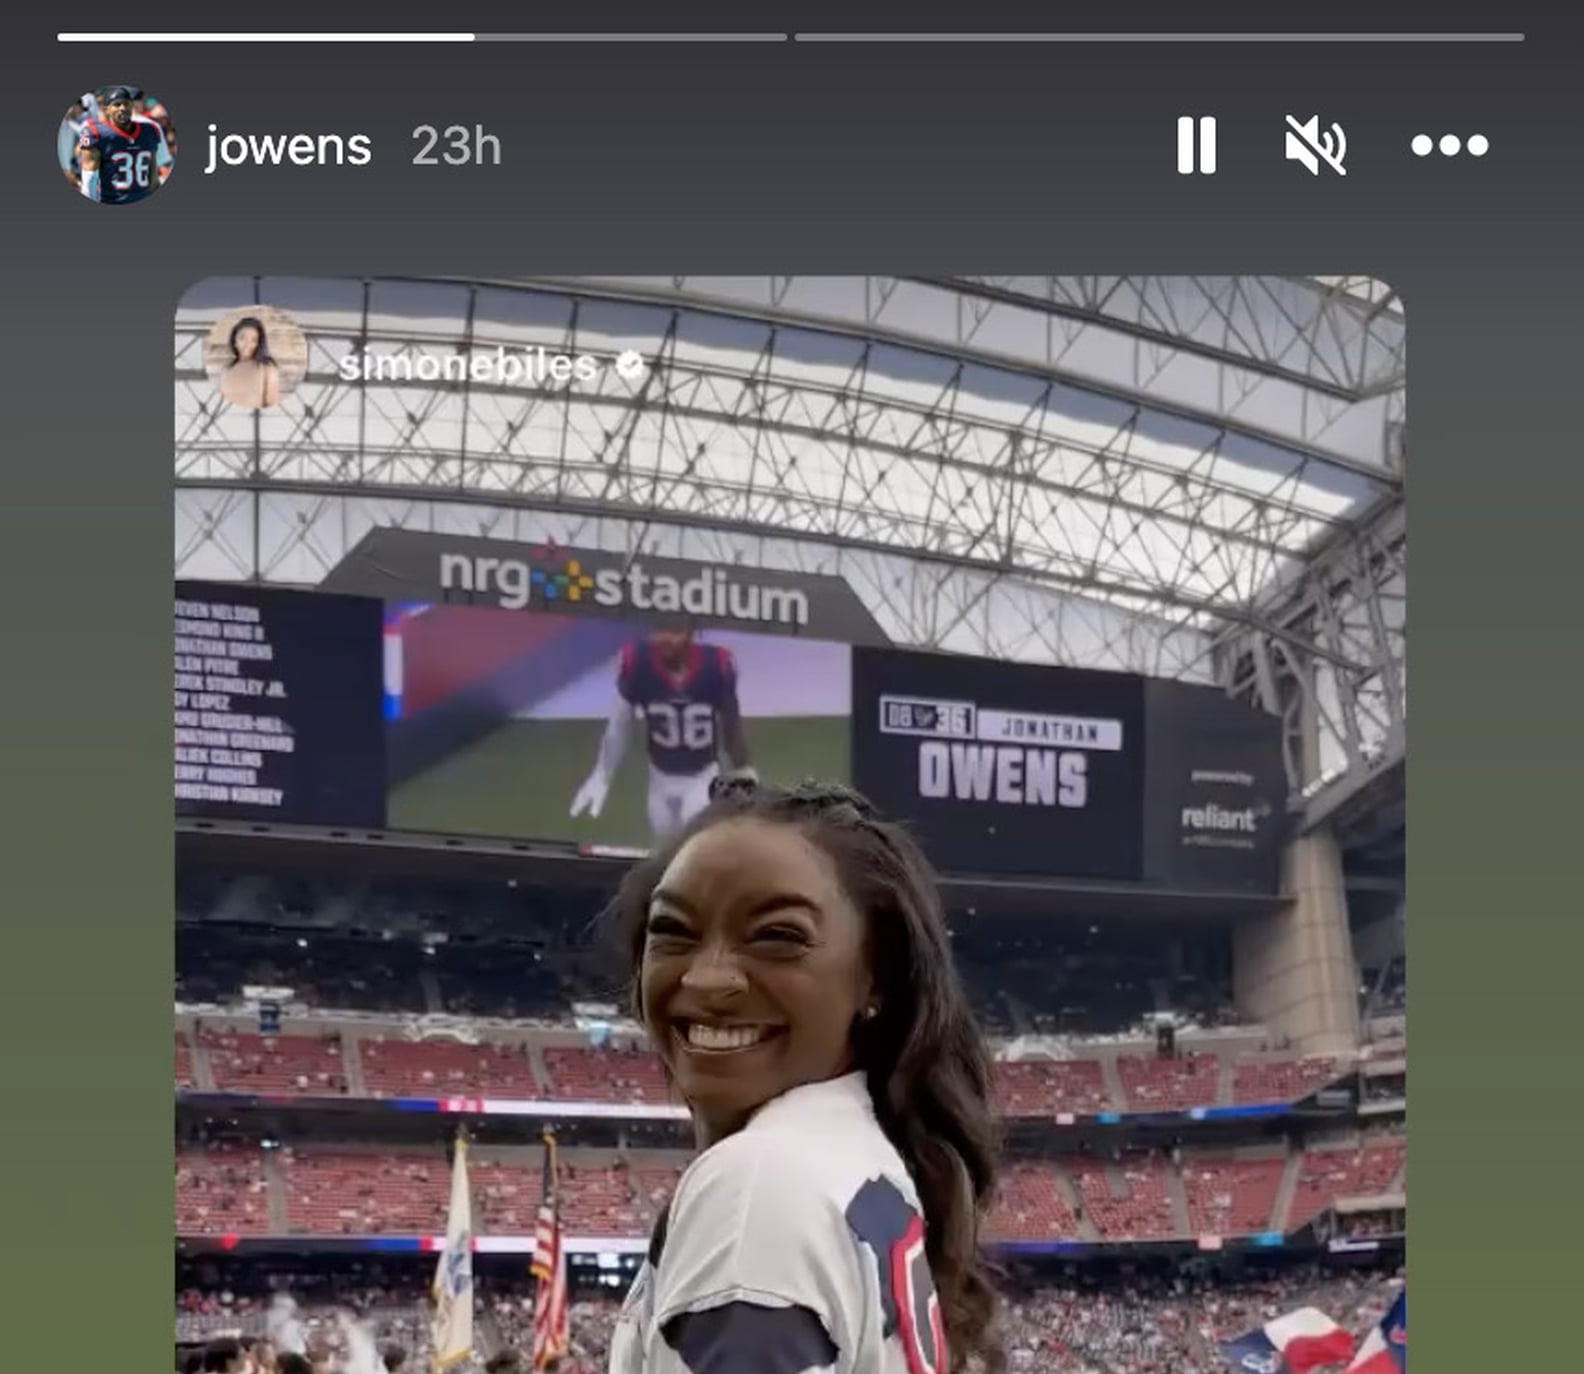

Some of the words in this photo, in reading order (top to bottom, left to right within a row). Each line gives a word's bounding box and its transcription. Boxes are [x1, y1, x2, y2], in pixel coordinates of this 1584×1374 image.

[111, 149, 152, 189] 36
[439, 552, 531, 610] nrg
[594, 561, 809, 625] stadium
[653, 701, 713, 750] 36
[1002, 718, 1099, 742] JONATHAN
[919, 741, 1087, 808] OWENS
[1182, 801, 1256, 832] reliant
